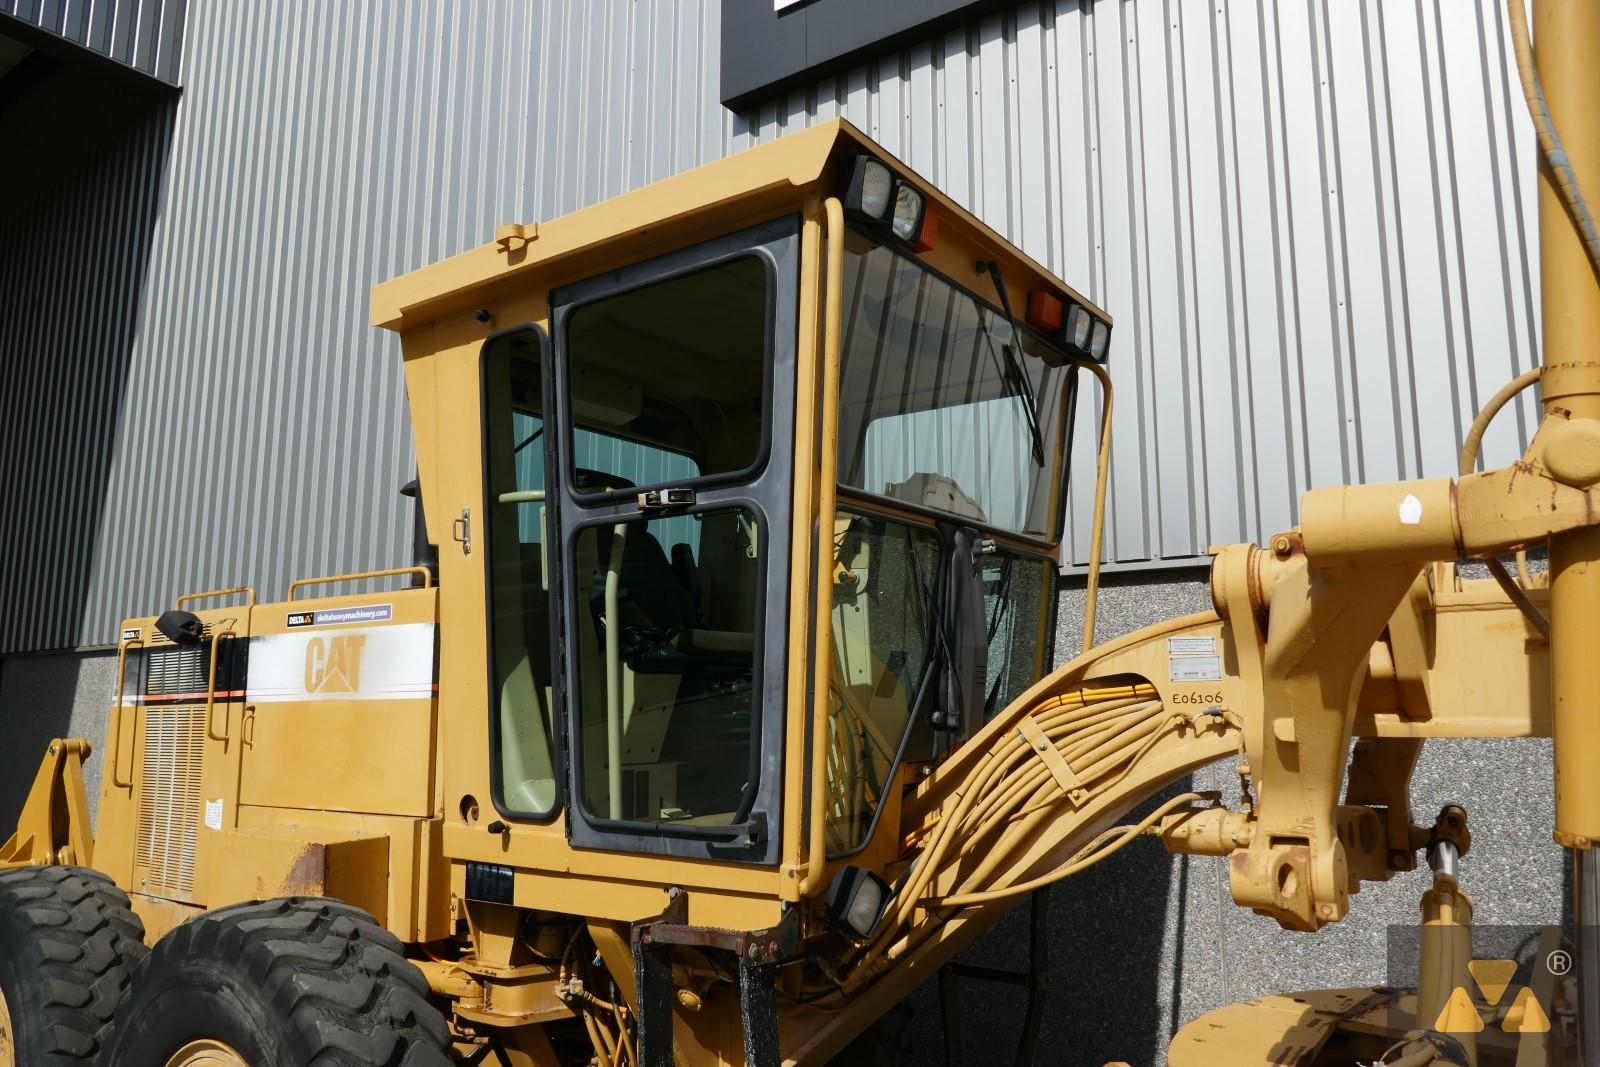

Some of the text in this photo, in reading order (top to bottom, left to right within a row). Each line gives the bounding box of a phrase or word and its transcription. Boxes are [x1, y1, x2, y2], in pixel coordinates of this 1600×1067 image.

[288, 615, 304, 625] DELTA
[304, 634, 368, 693] CAT
[1172, 691, 1224, 704] E06106
